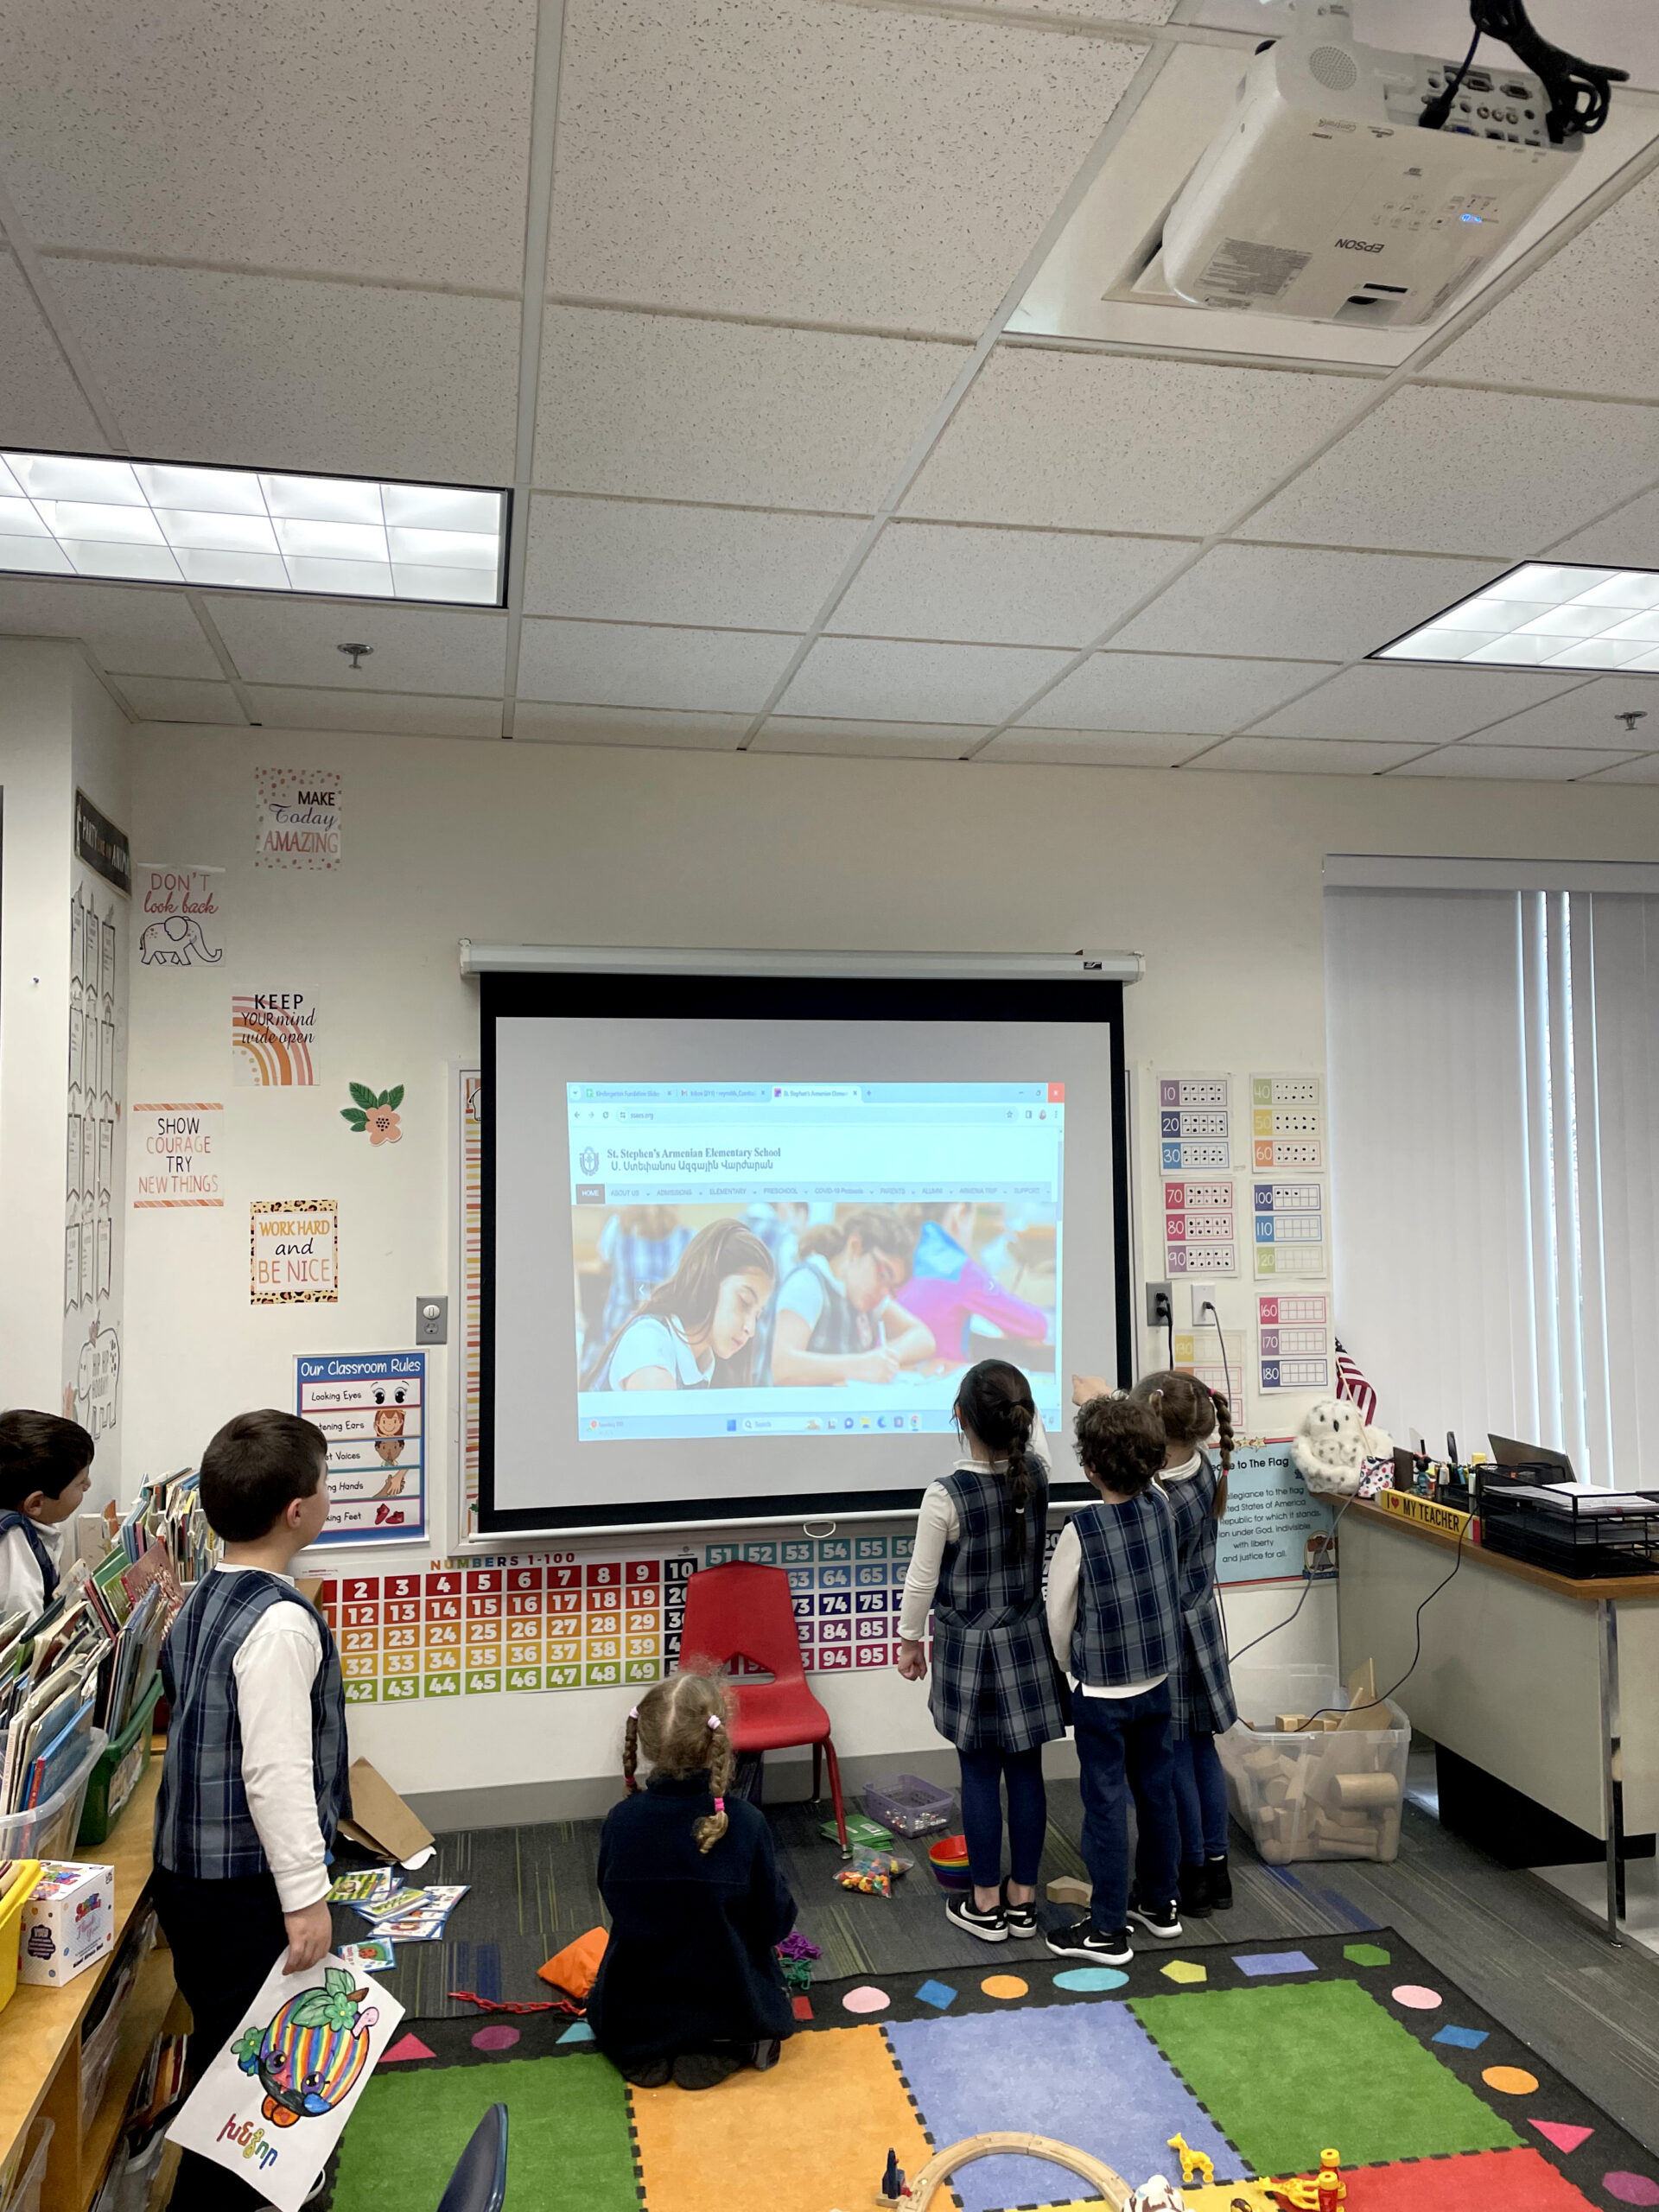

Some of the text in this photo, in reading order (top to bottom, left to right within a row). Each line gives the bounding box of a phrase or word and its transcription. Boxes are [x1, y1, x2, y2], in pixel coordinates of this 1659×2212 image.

[1335, 238, 1384, 253] EPSON
[298, 791, 335, 805] MAKE
[269, 803, 338, 830] Today
[264, 830, 338, 854] AMAZING
[151, 873, 211, 891] DON'T
[144, 891, 219, 914] look back
[254, 994, 303, 1009] KEEP
[241, 1007, 316, 1027] YOUR mind
[242, 1026, 315, 1050] wide open
[1164, 1087, 1175, 1100] 10
[1255, 1086, 1270, 1099] 40
[158, 1118, 200, 1135] SHOW
[1163, 1118, 1179, 1131] 20
[146, 1136, 211, 1154] COURAGE
[607, 1147, 781, 1160] St. Stephen's Armenian Elementary School
[1164, 1149, 1180, 1163] 30
[1256, 1147, 1272, 1160] 60
[166, 1156, 192, 1173] TRY
[139, 1174, 219, 1193] NEW THINGS
[1167, 1190, 1183, 1203] 70
[1255, 1192, 1272, 1205] 100
[259, 1220, 330, 1236] WORK HARD
[1168, 1221, 1184, 1234] 80
[1256, 1223, 1273, 1236] 110
[275, 1237, 314, 1255] and
[1168, 1252, 1185, 1266] 90
[1257, 1254, 1274, 1267] 120
[258, 1259, 330, 1283] BE NICE
[1261, 1306, 1278, 1317] 160
[1263, 1337, 1278, 1349] 170
[301, 1357, 421, 1376] Our Classroom Rules
[1263, 1368, 1279, 1380] 180
[311, 1391, 362, 1402] Looking Eyes
[319, 1421, 365, 1432] tening Ears
[336, 1452, 360, 1460] Voices
[1237, 1460, 1247, 1469] to
[1249, 1459, 1266, 1468] The
[1268, 1458, 1289, 1467] Flag
[340, 1482, 364, 1491] Hands
[1274, 1499, 1306, 1508] America
[344, 1512, 361, 1521] Feet
[1255, 1514, 1263, 1522] for
[1387, 1495, 1459, 1533] I MY TEACHER
[748, 1547, 773, 1562] 52
[785, 1545, 810, 1560] 53
[823, 1543, 847, 1559] 54
[860, 1541, 883, 1556] 55
[1233, 1540, 1249, 1548] with
[430, 1553, 575, 1571] NUMBERS 1-100
[1239, 1554, 1263, 1562] justice
[354, 1562, 694, 1599] 2 3 4 5 6 7 8 9 10
[823, 1570, 847, 1586] 64
[860, 1567, 883, 1583] 65
[348, 1607, 374, 1624] 12
[391, 1604, 416, 1621] 13
[431, 1601, 456, 1618] 14
[472, 1599, 497, 1616] 15
[512, 1597, 537, 1613] 16
[553, 1594, 577, 1611] 17
[592, 1592, 617, 1608] 18
[632, 1589, 655, 1605] 19
[823, 1597, 847, 1612] 74
[860, 1594, 883, 1610] 75
[346, 1632, 373, 1649] 22
[389, 1629, 415, 1646] 23
[429, 1626, 456, 1643] 24
[471, 1624, 497, 1640] 25
[512, 1621, 537, 1638] 26
[551, 1619, 577, 1635] 27
[591, 1617, 616, 1633] 28
[631, 1614, 655, 1630] 29
[823, 1624, 847, 1639] 84
[860, 1621, 884, 1637] 85
[346, 1658, 372, 1675] 32
[388, 1655, 414, 1672] 33
[429, 1651, 456, 1669] 34
[470, 1649, 497, 1665] 35
[511, 1646, 537, 1662] 36
[551, 1643, 577, 1660] 37
[591, 1641, 616, 1657] 38
[630, 1638, 655, 1655] 39
[823, 1650, 847, 1666] 94
[860, 1648, 884, 1663] 95
[346, 1683, 372, 1700] 42
[388, 1680, 414, 1697] 43
[429, 1676, 455, 1694] 44
[470, 1674, 496, 1690] 45
[511, 1671, 537, 1687] 46
[550, 1669, 577, 1684] 47
[591, 1666, 616, 1681] 48
[630, 1663, 655, 1679] 49
